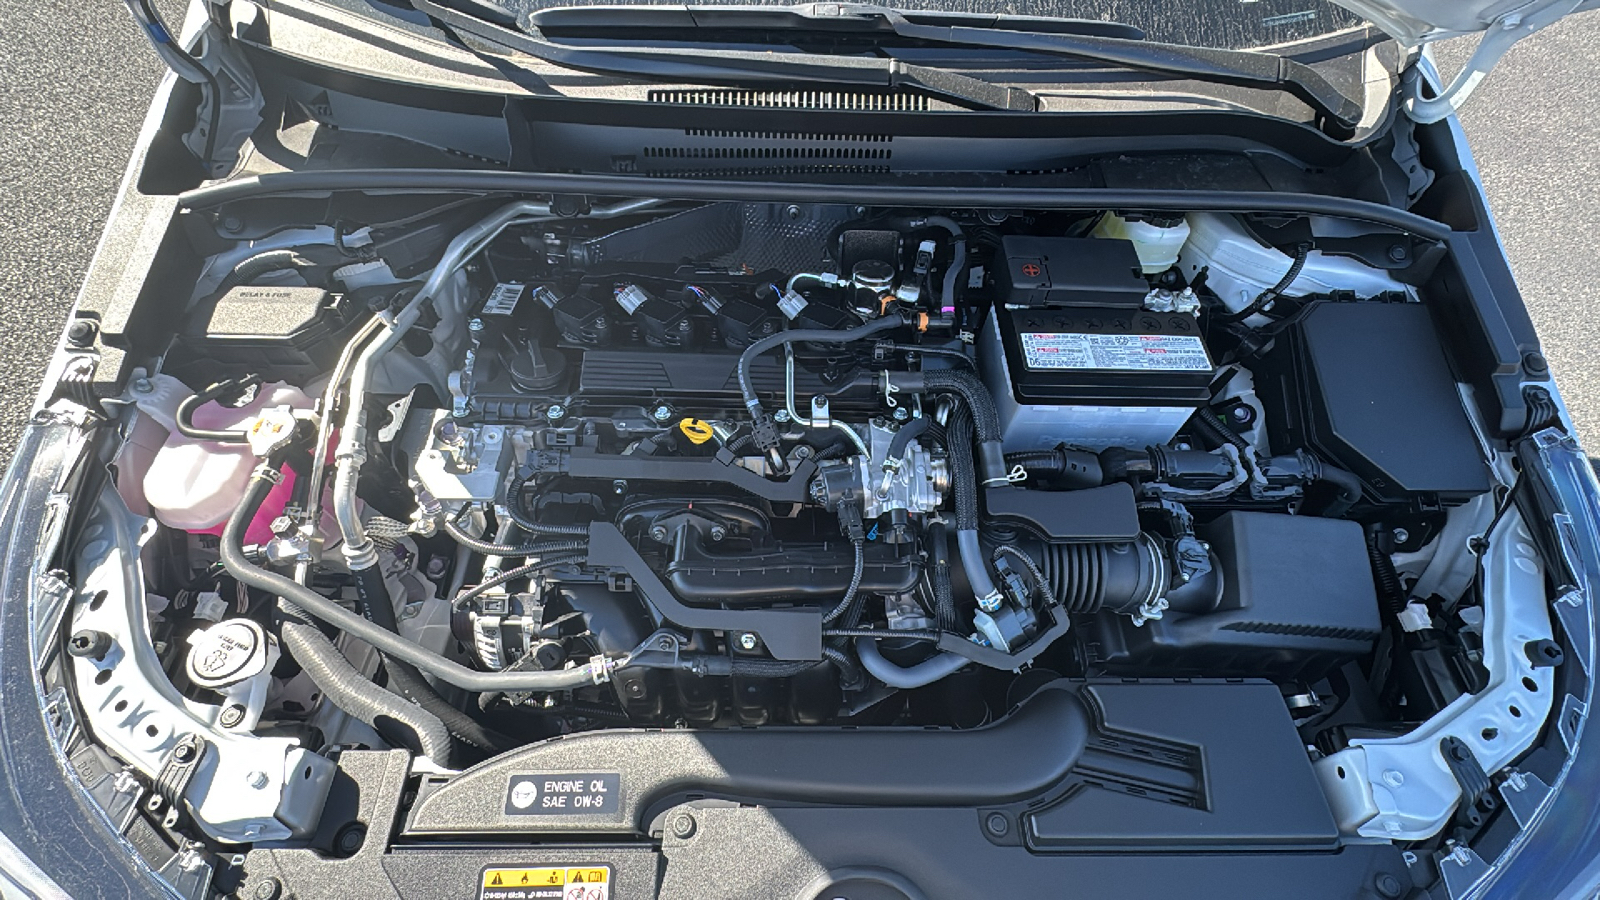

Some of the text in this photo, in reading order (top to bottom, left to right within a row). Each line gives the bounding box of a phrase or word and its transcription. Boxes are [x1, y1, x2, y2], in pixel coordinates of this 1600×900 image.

[544, 779, 608, 793] ENGINE OIL
[542, 795, 568, 808] SAE
